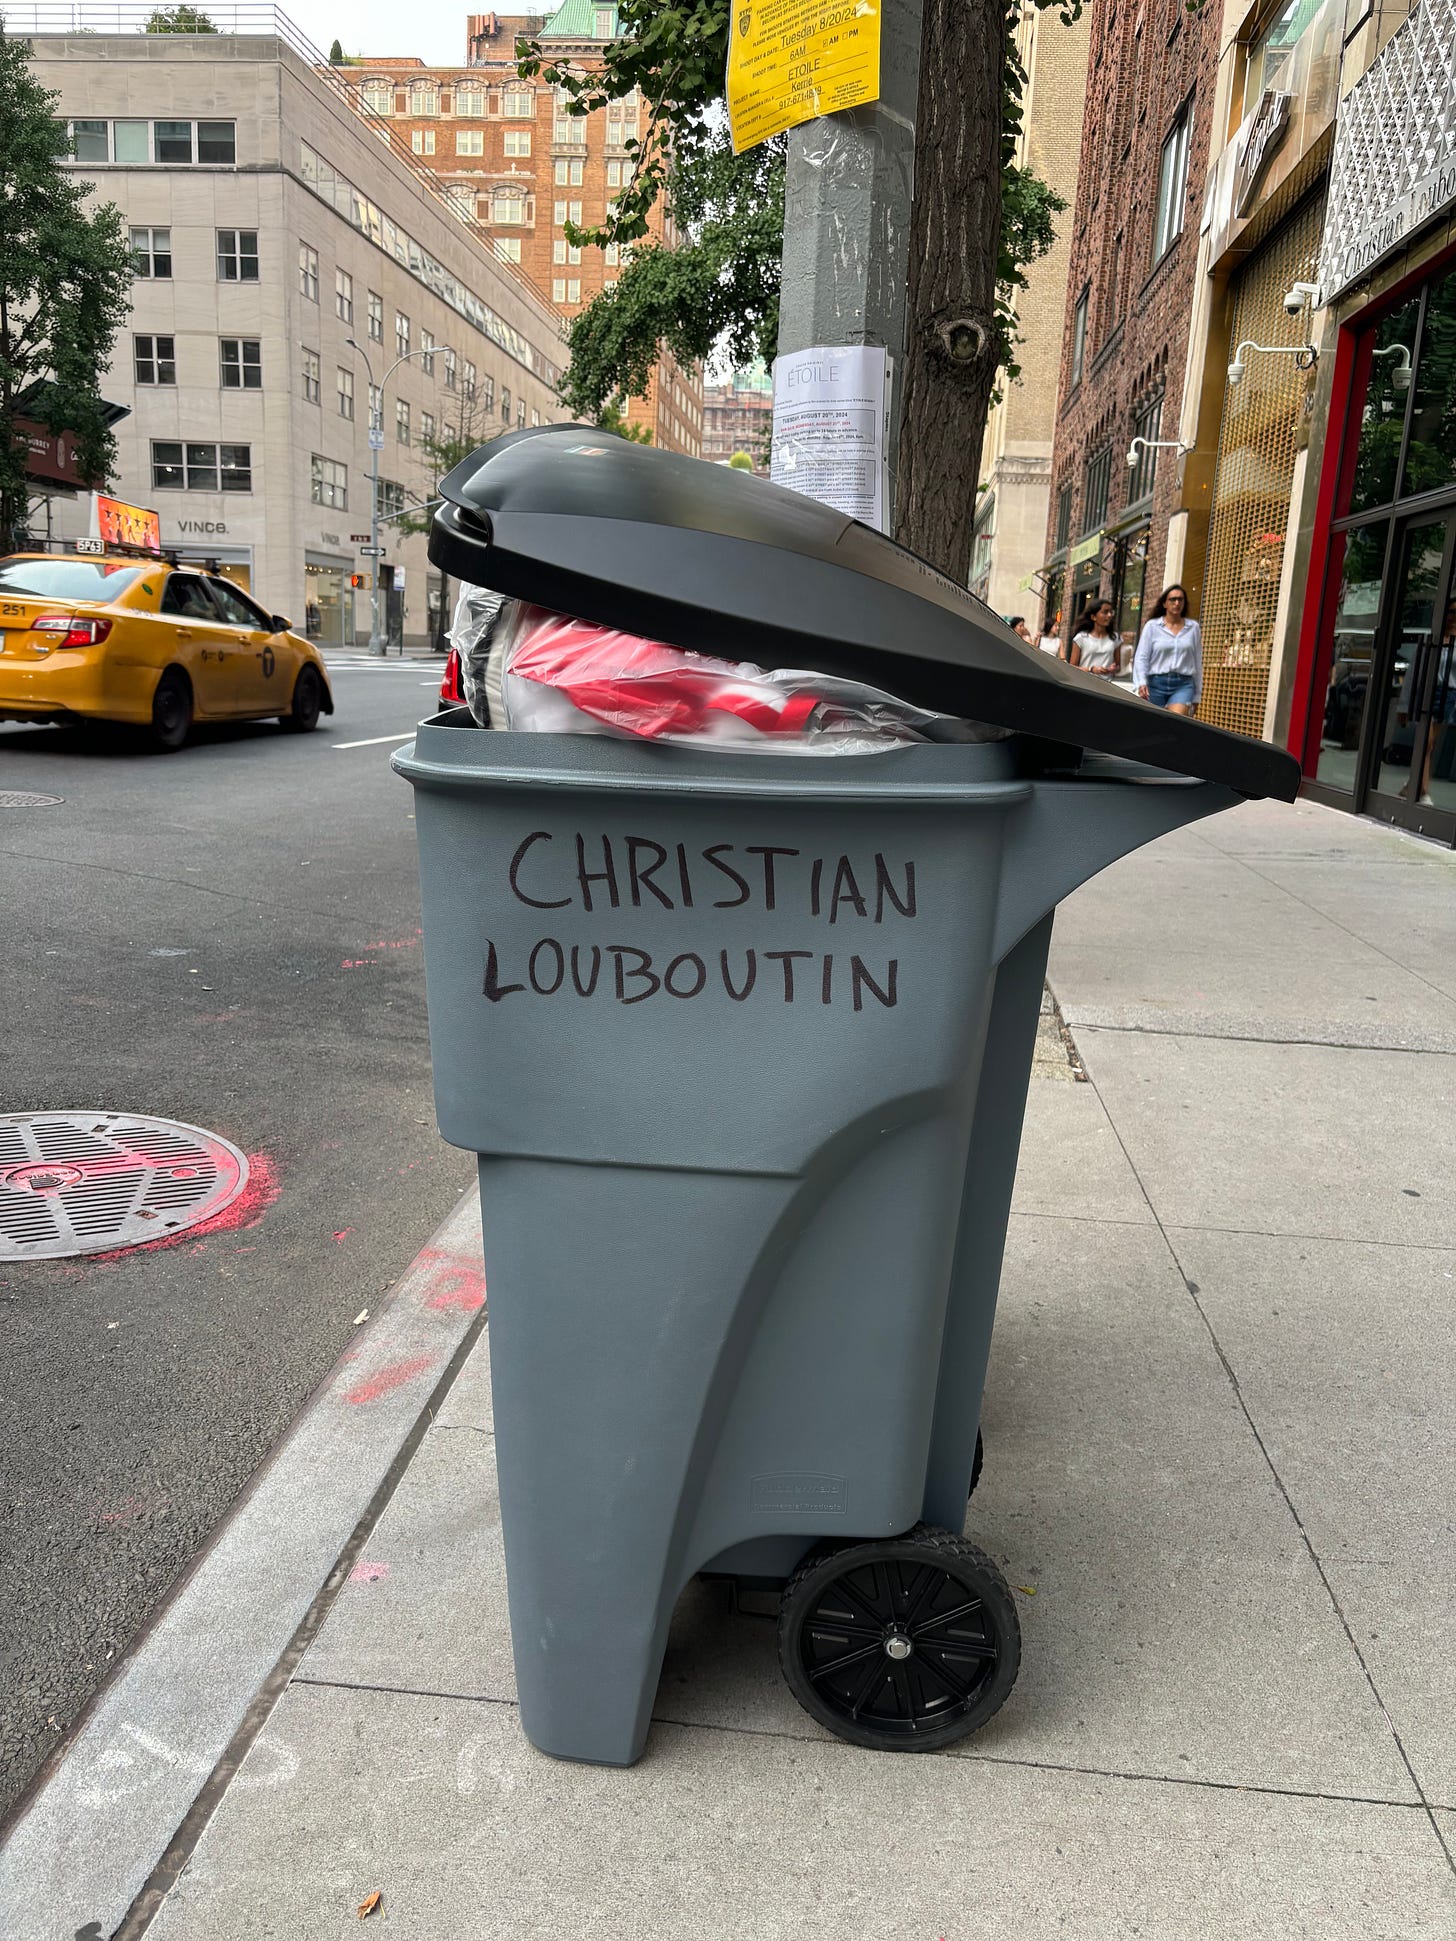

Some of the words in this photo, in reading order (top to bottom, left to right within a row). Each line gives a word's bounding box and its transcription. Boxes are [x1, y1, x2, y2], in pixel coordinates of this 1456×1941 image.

[781, 22, 817, 48] Tuesday
[820, 6, 857, 30] 8/20/24
[790, 44, 806, 60] 6AM
[829, 35, 839, 45] AM
[848, 28, 859, 39] PM
[788, 58, 820, 81] ETOILE
[791, 77, 812, 93] Kerrie
[1345, 211, 1403, 279] Christian
[788, 365, 840, 387] ÉTOILE
[801, 412, 820, 420] AUGUST
[2, 604, 26, 617] 251
[508, 831, 917, 924] CHRISTIAN
[482, 937, 898, 1012] LOUBOUTIN
